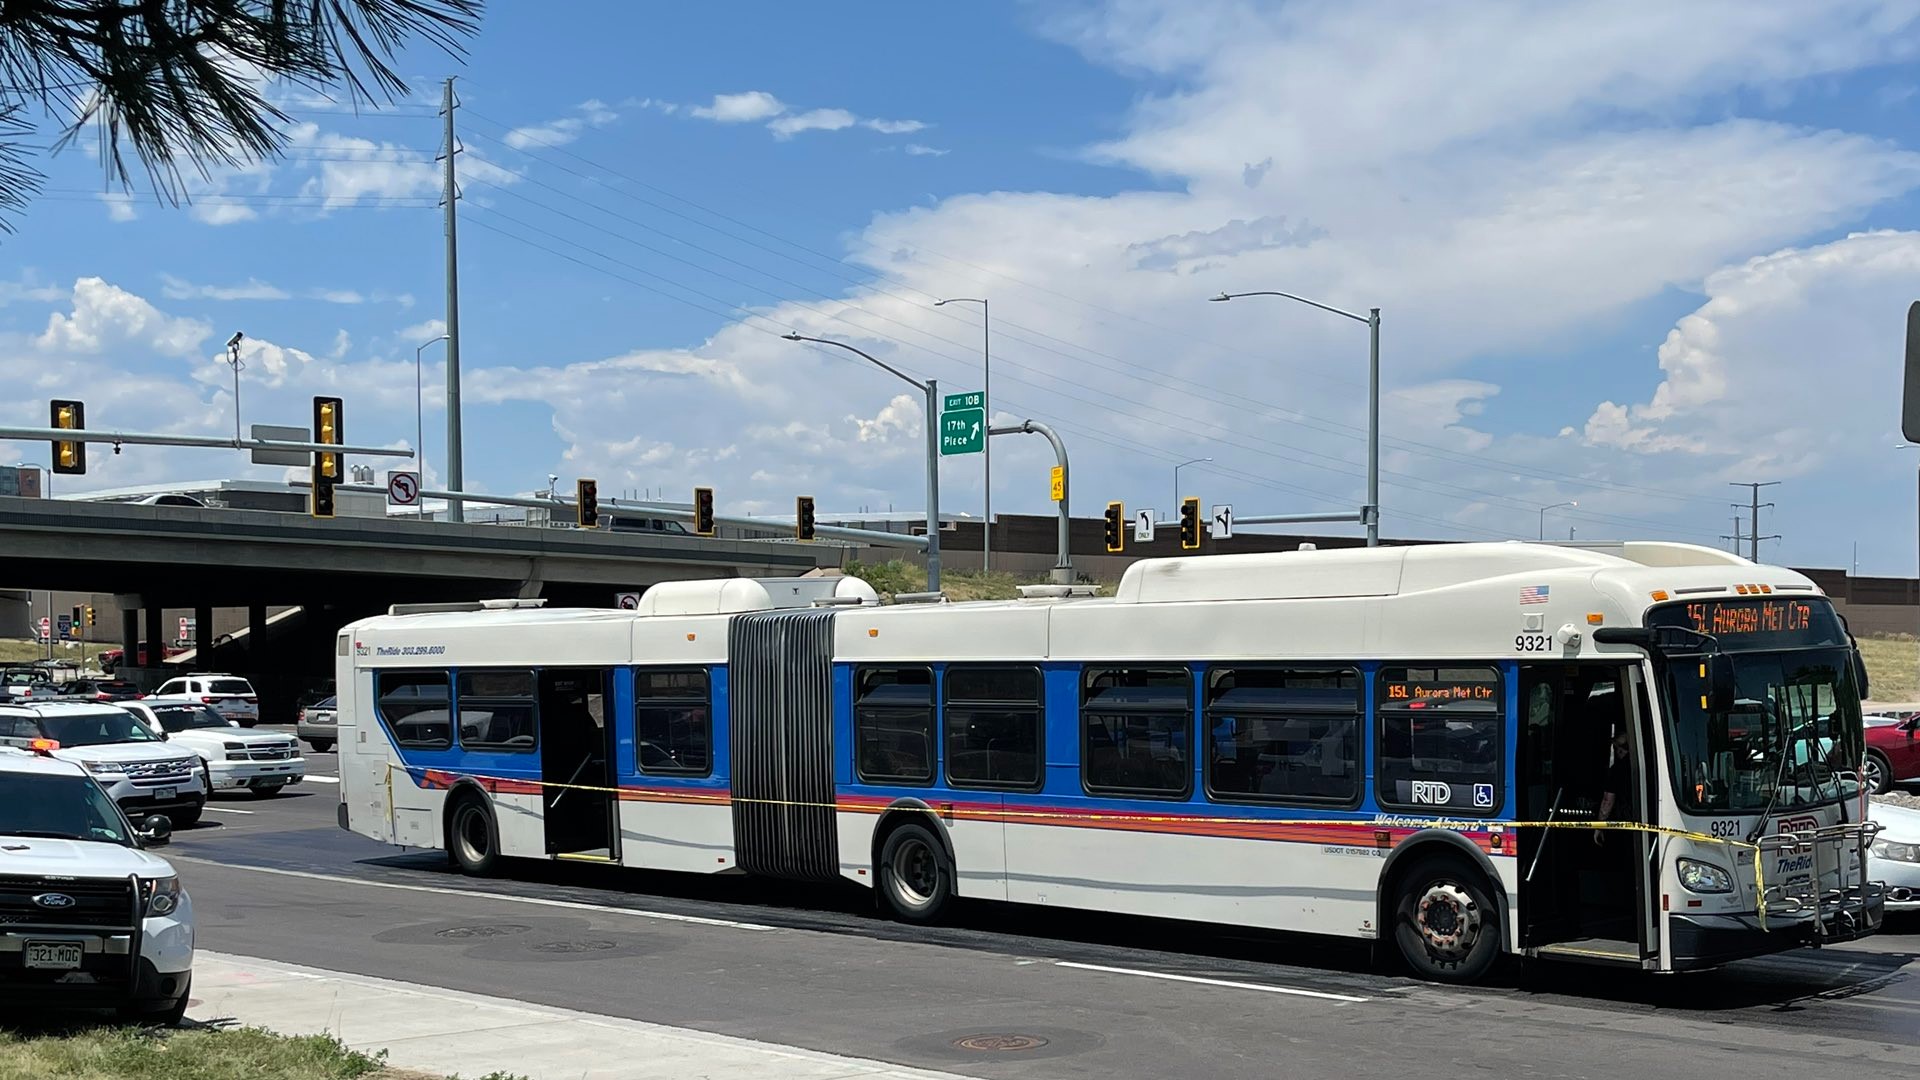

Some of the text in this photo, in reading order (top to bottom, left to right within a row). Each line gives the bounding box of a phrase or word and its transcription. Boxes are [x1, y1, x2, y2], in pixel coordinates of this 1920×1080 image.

[965, 395, 979, 406] 10B
[947, 420, 966, 431] 17th
[944, 436, 968, 446] Place
[1053, 481, 1062, 491] 45
[1515, 635, 1552, 651] 9321
[376, 646, 400, 656] TheRide
[1388, 685, 1493, 698] 15L Aurora Met Ctr
[1411, 780, 1451, 805] RTD
[1374, 814, 1430, 828] Welcome
[1711, 820, 1741, 837] 9321
[1777, 855, 1813, 873] TheRid
[44, 895, 67, 905] Ford
